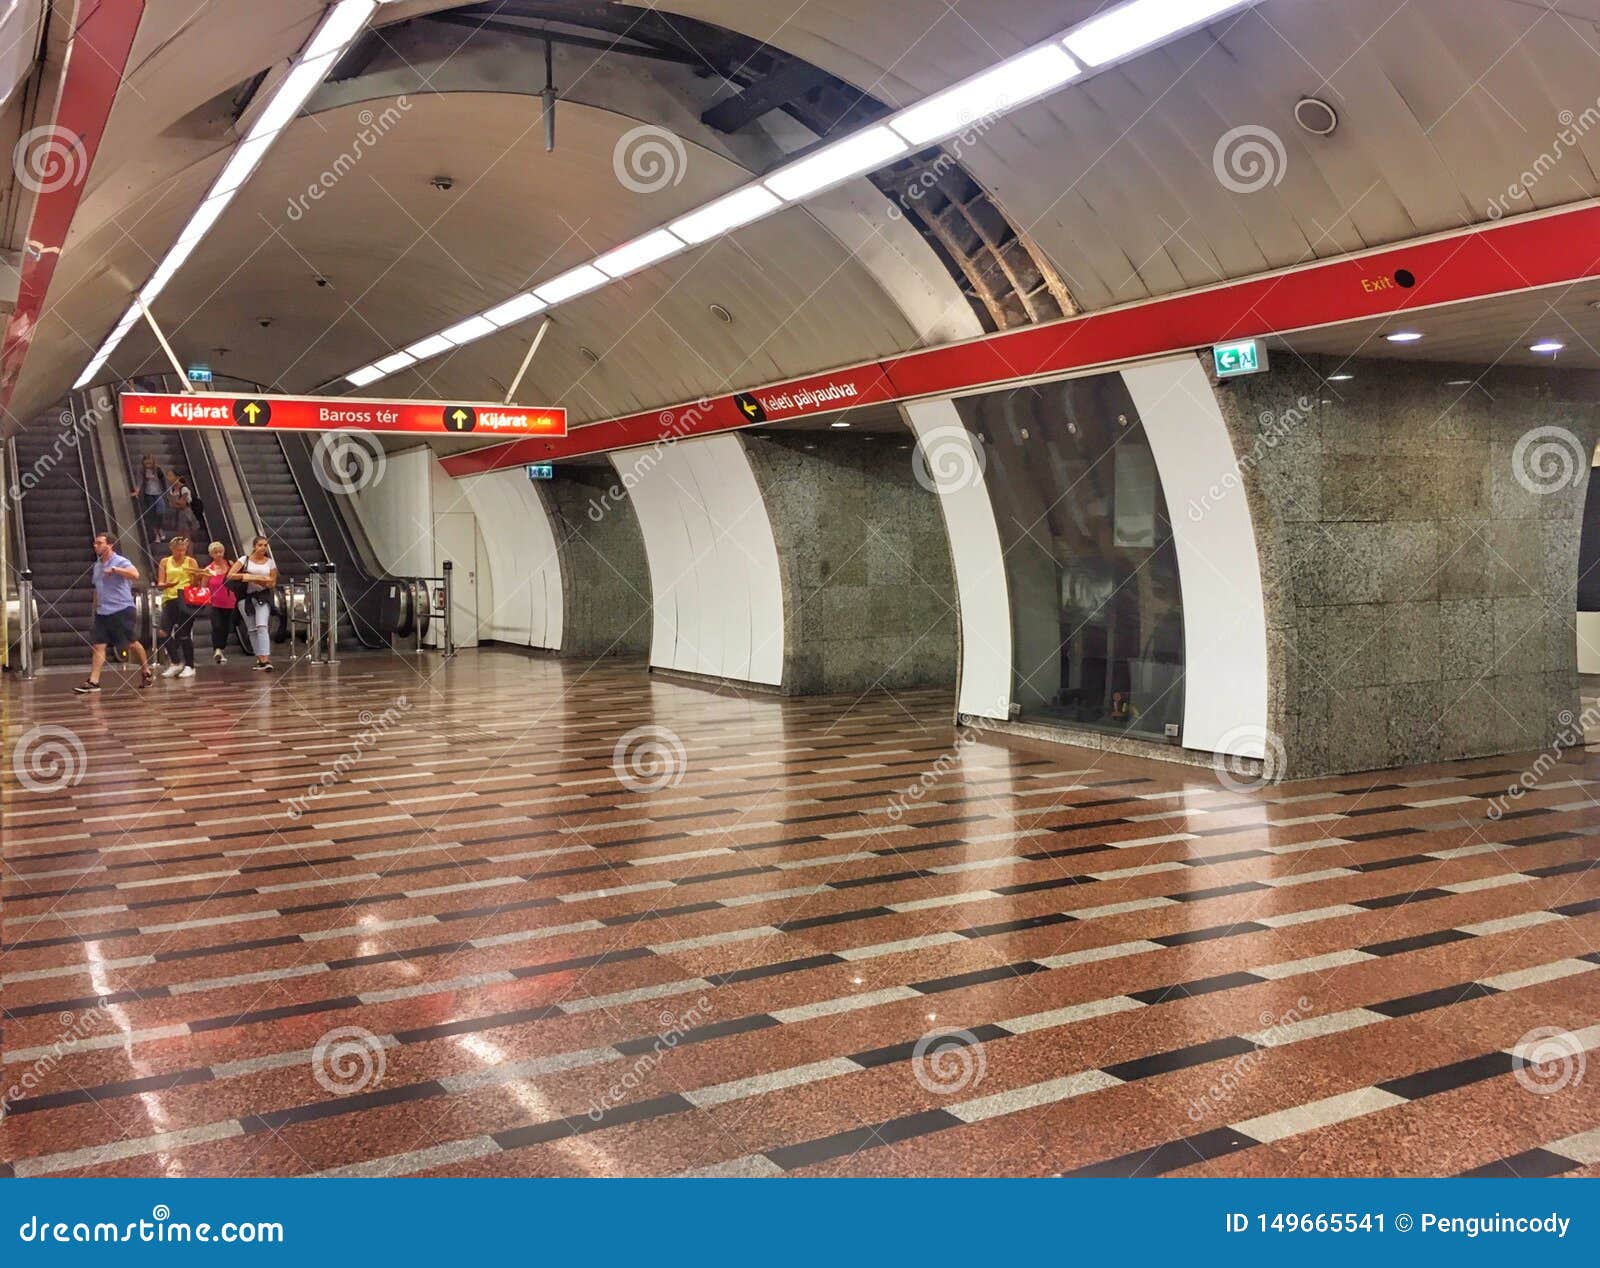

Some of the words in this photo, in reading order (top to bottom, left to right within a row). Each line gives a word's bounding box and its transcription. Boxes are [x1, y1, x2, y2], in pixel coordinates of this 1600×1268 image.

[1361, 276, 1394, 293] Exit
[759, 391, 794, 412] Keleti
[793, 382, 858, 409] pályaudvar
[139, 405, 157, 415] Exit
[170, 403, 229, 421] Kijárat
[319, 407, 371, 423] Baross
[376, 409, 399, 424] tér
[479, 412, 528, 430] Kijárat
